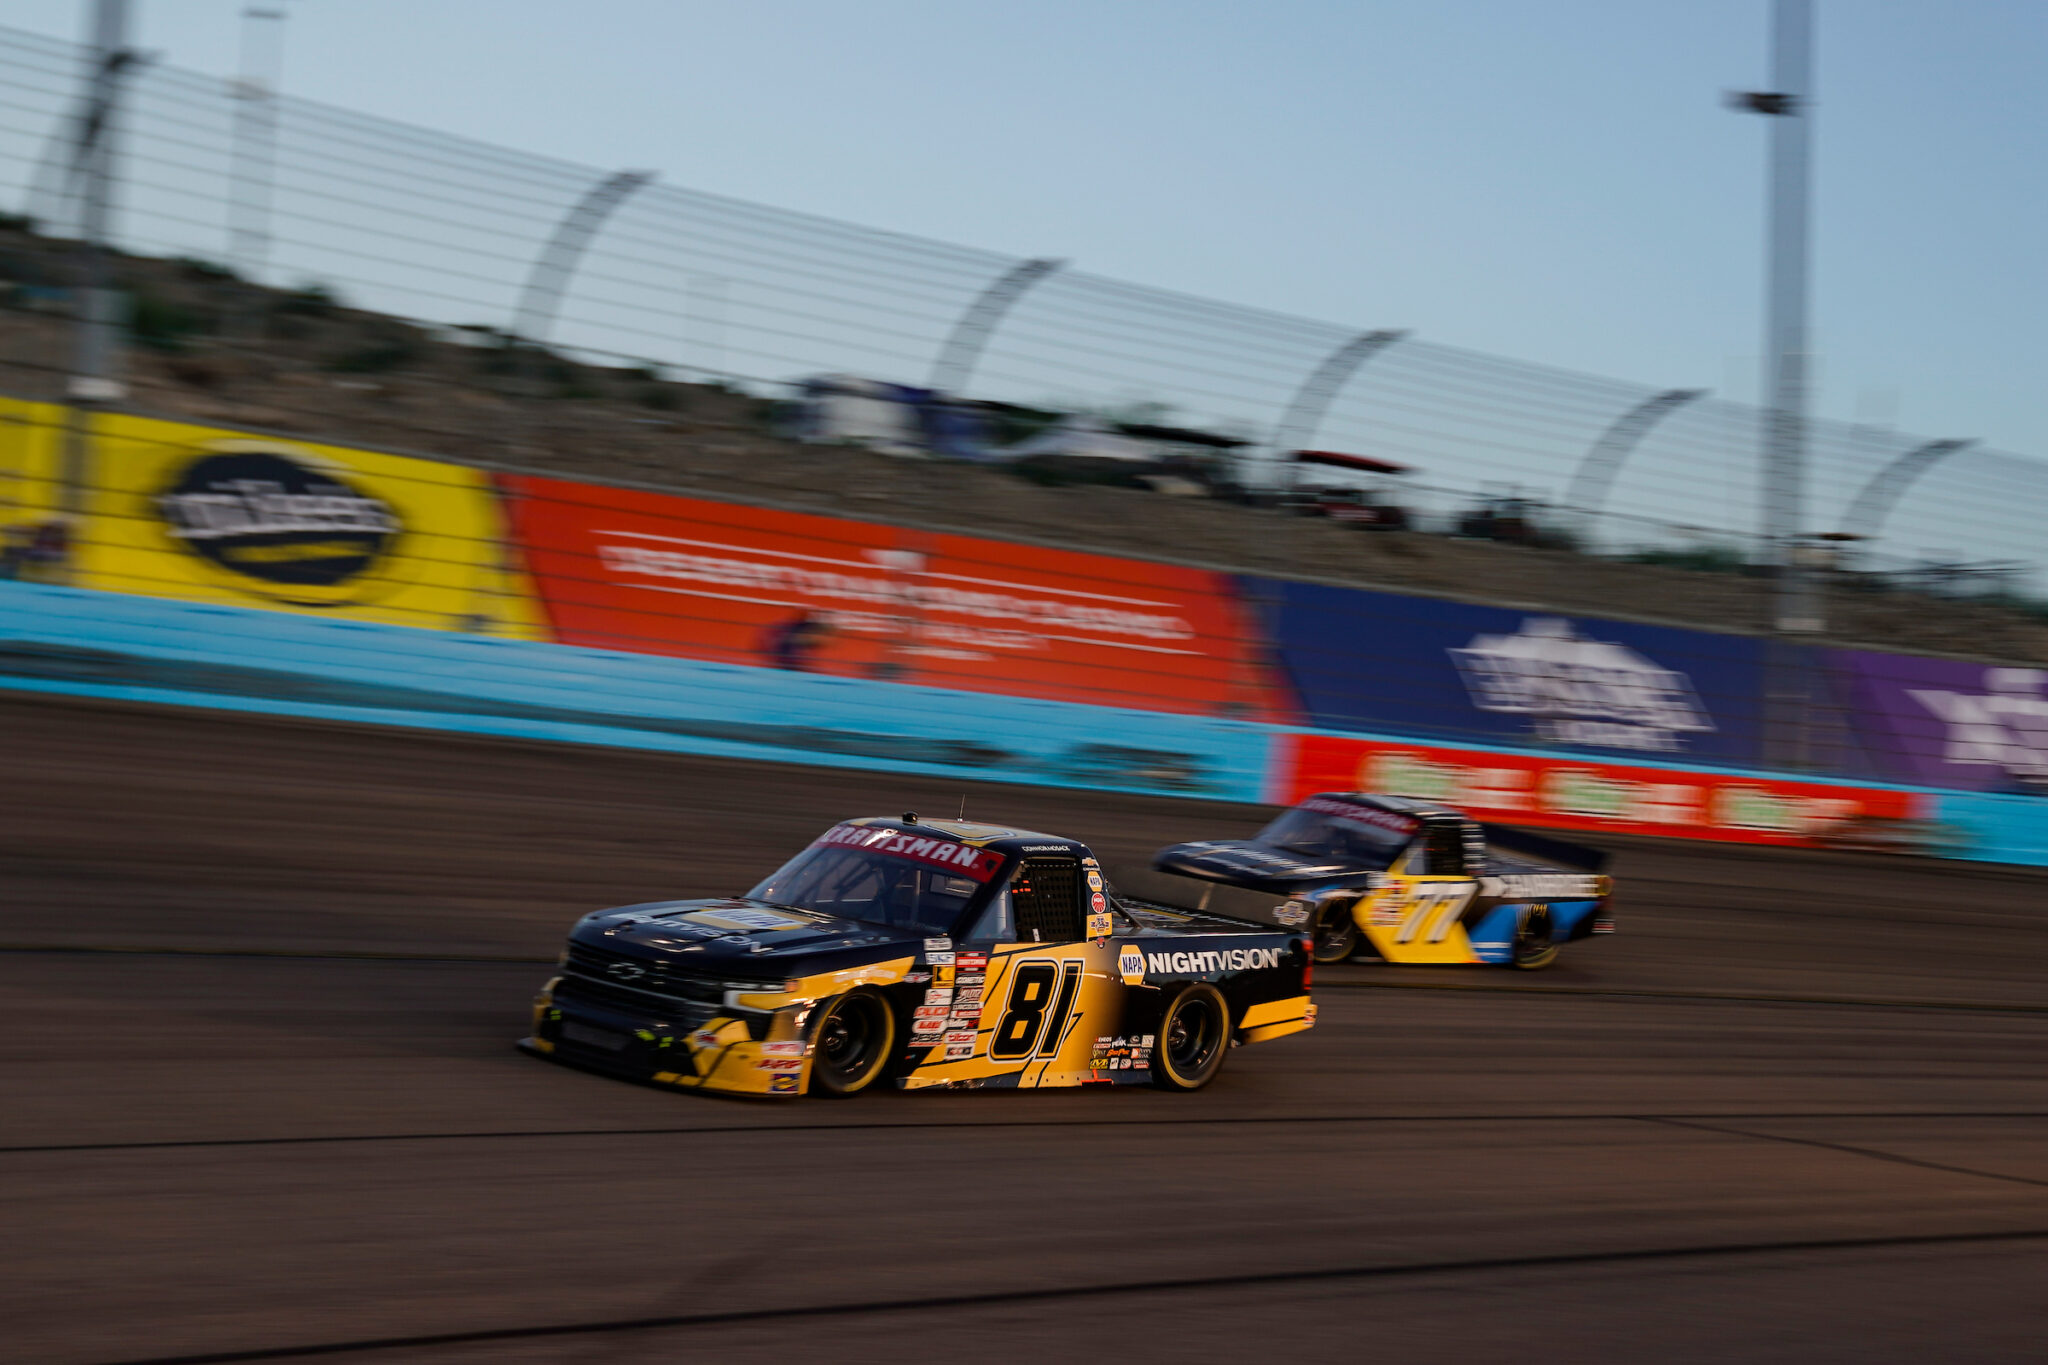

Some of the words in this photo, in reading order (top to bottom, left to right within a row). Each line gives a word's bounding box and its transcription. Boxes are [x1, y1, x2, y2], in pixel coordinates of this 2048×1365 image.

[826, 826, 981, 868] CRAFTSMAN
[1394, 881, 1479, 943] 77
[1122, 956, 1143, 974] NAPA
[1147, 948, 1280, 974] NIGHTVISION
[988, 958, 1084, 1063] 81
